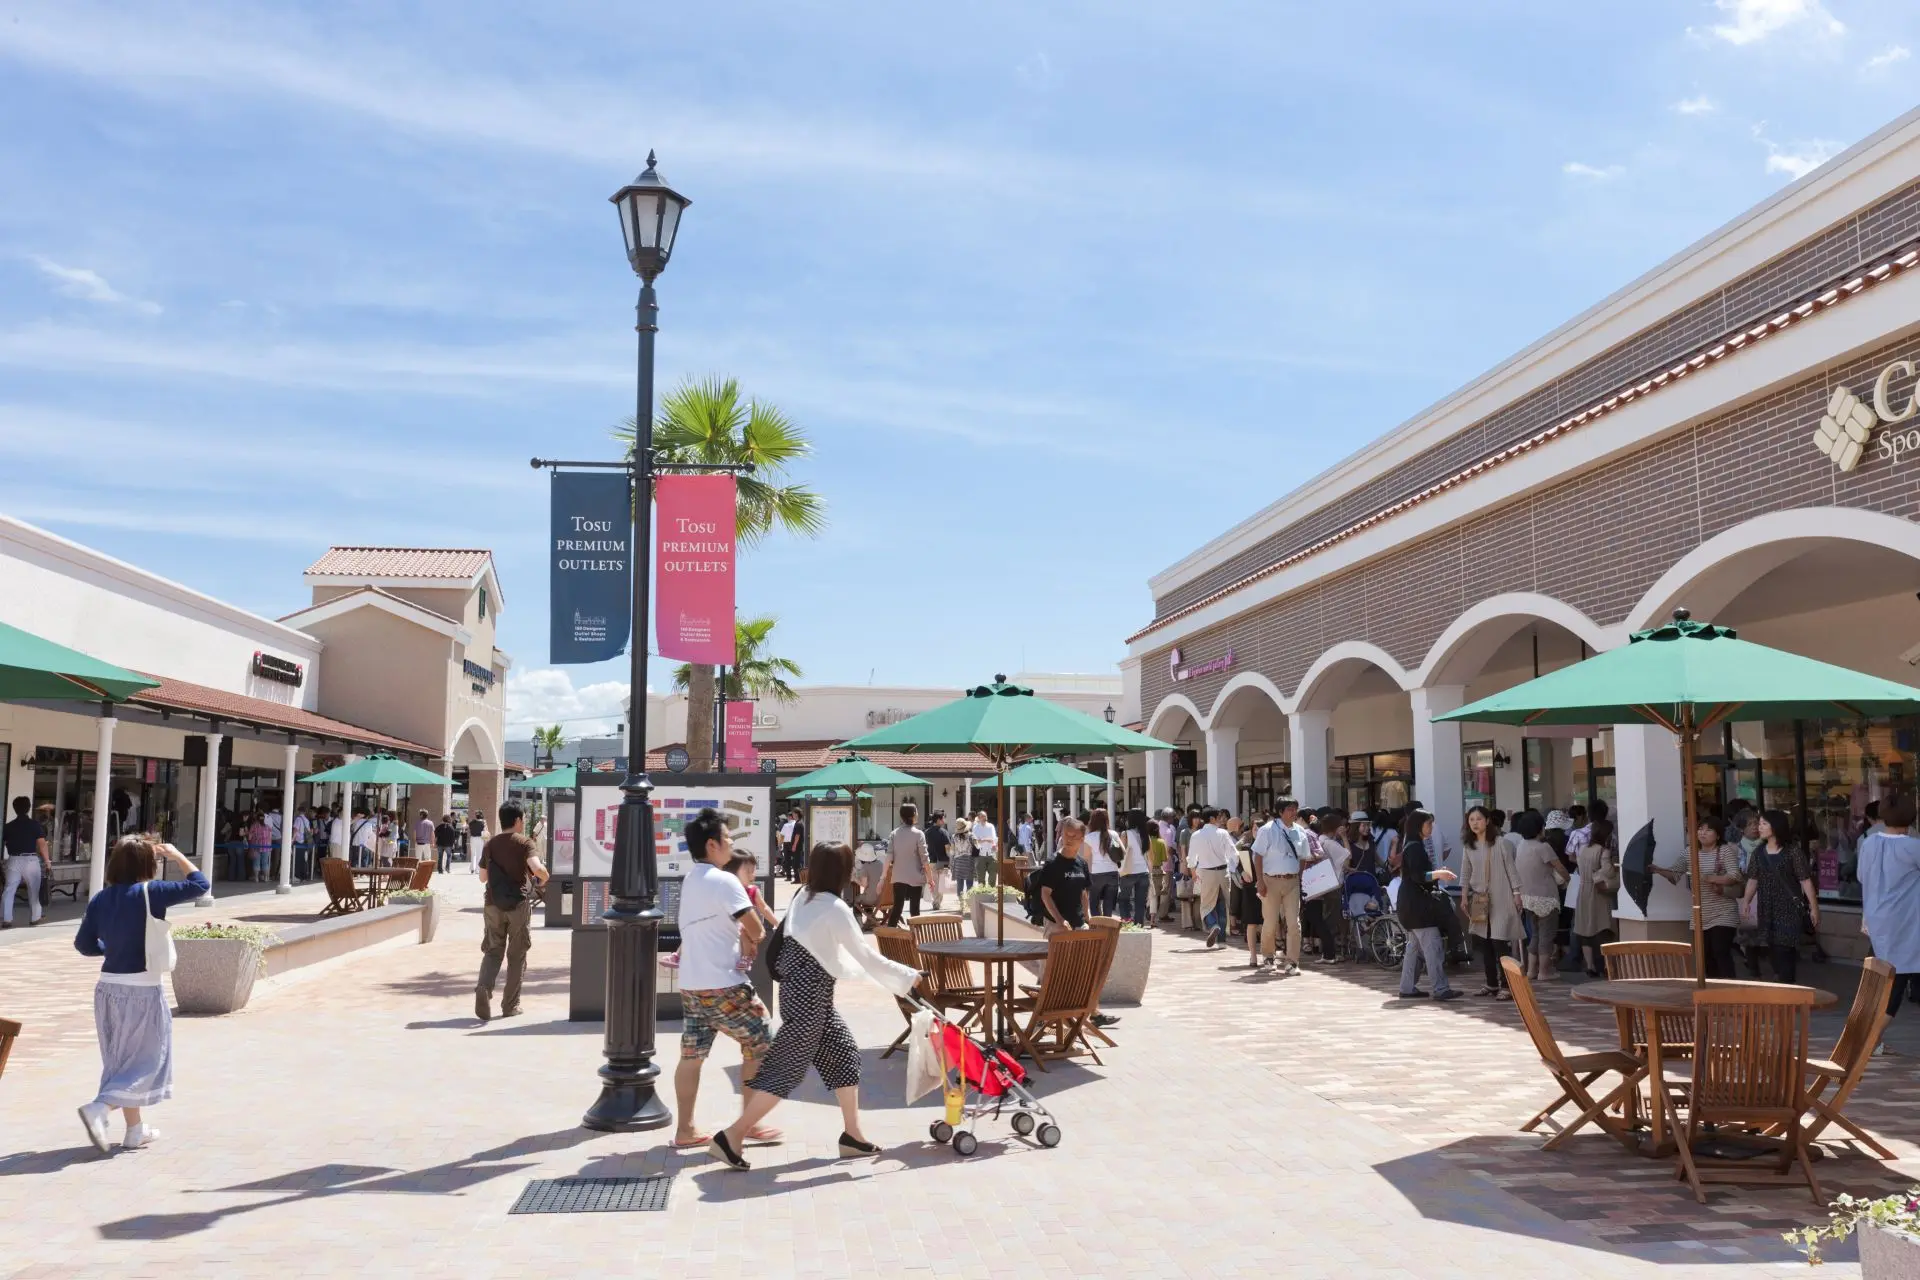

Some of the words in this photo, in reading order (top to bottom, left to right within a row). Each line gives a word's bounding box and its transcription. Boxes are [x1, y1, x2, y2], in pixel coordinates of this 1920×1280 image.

[1874, 360, 1920, 422] C
[557, 540, 625, 551] PREMIUM
[663, 542, 729, 553] PREMIUM
[559, 559, 624, 571] OUTLETS
[664, 561, 728, 572] OUTLETS
